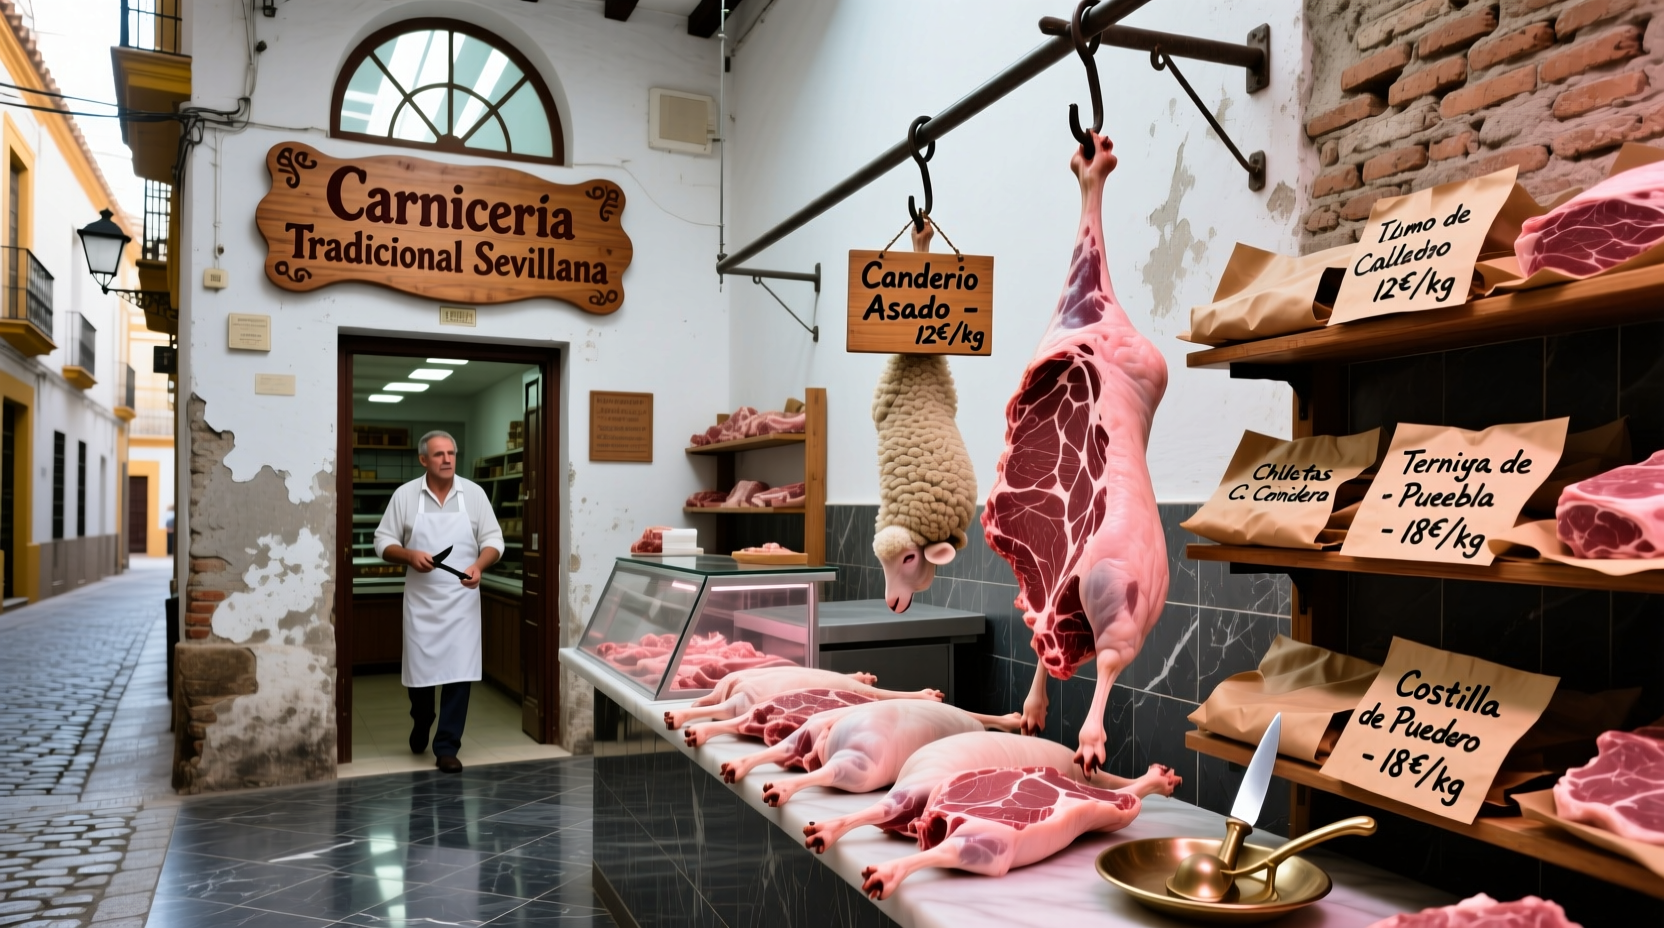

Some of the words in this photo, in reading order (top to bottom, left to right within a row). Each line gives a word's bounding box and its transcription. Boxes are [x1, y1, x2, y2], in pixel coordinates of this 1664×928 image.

[1443, 203, 1471, 228] de
[284, 222, 464, 274] Tradicional
[473, 240, 609, 285] Sevillana
[861, 260, 979, 291] Canderio
[1373, 267, 1456, 302] 12€/kg
[862, 294, 951, 321] Asado
[915, 320, 985, 352] 12€/kg
[1500, 449, 1533, 475] de
[1398, 482, 1495, 508] Pueebla
[1400, 517, 1486, 559] 18€/kg
[1396, 669, 1501, 718] Costilla
[1358, 702, 1385, 729] de
[1388, 706, 1481, 753] Puedero
[1379, 748, 1465, 807] 18€/kg
